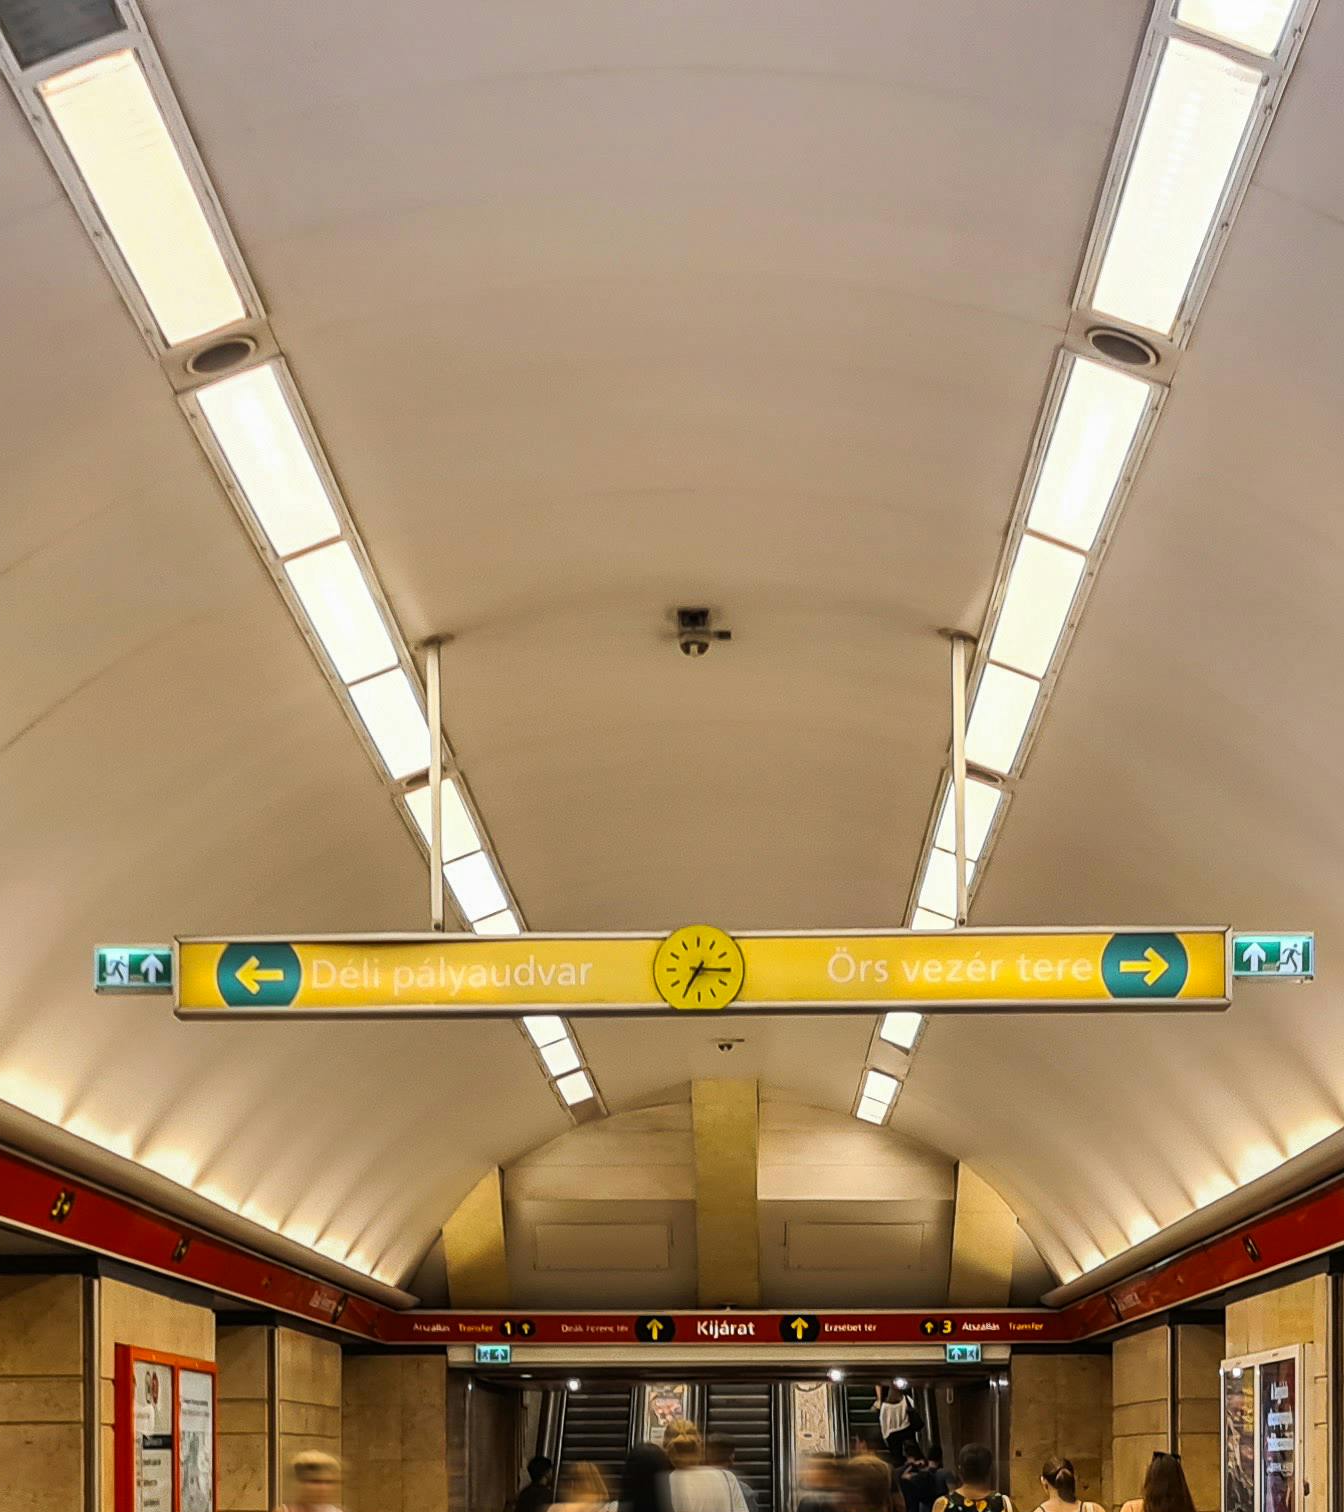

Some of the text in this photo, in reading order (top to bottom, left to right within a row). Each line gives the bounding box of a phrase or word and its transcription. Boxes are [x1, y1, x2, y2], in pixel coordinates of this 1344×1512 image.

[311, 954, 592, 996] Déli pályaudvar
[901, 951, 1003, 983] vezér
[1018, 953, 1093, 982] tere
[504, 1320, 512, 1335] 1
[697, 1319, 756, 1339] Kijárat
[942, 1319, 952, 1334] 3
